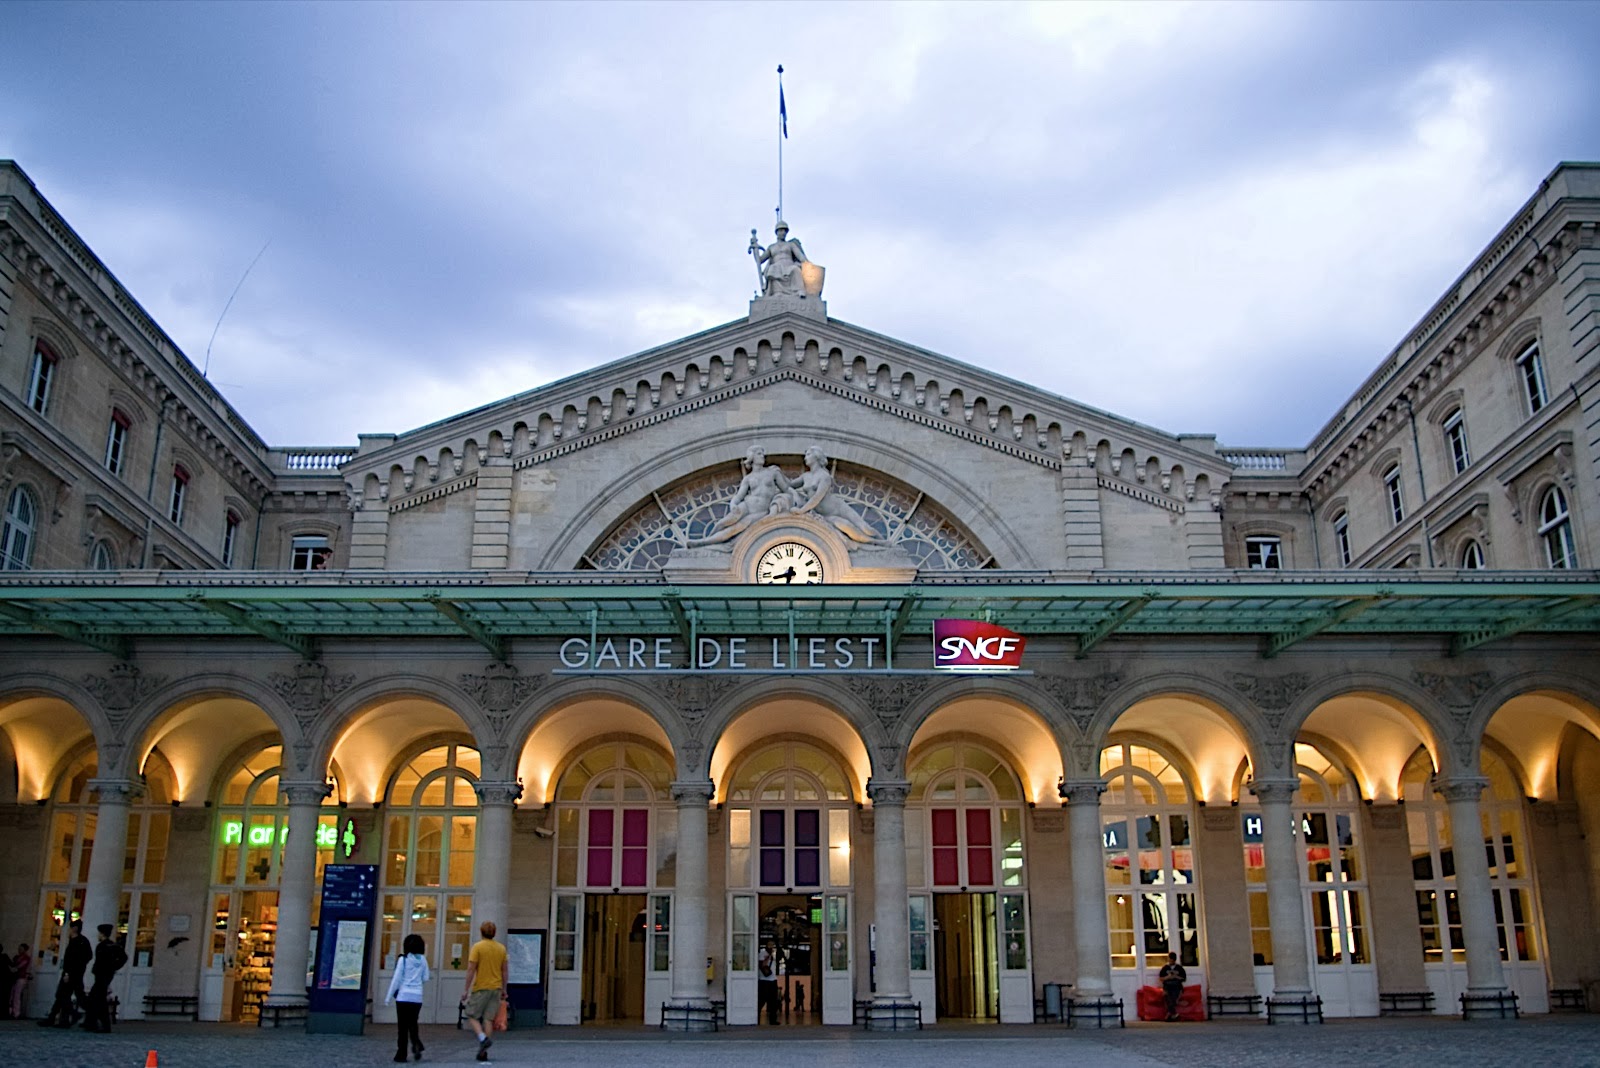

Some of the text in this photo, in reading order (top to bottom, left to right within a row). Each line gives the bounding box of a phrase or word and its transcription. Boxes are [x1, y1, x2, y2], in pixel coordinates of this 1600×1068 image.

[559, 637, 880, 668] GARE DE L'EST
[938, 636, 1021, 660] SNCF
